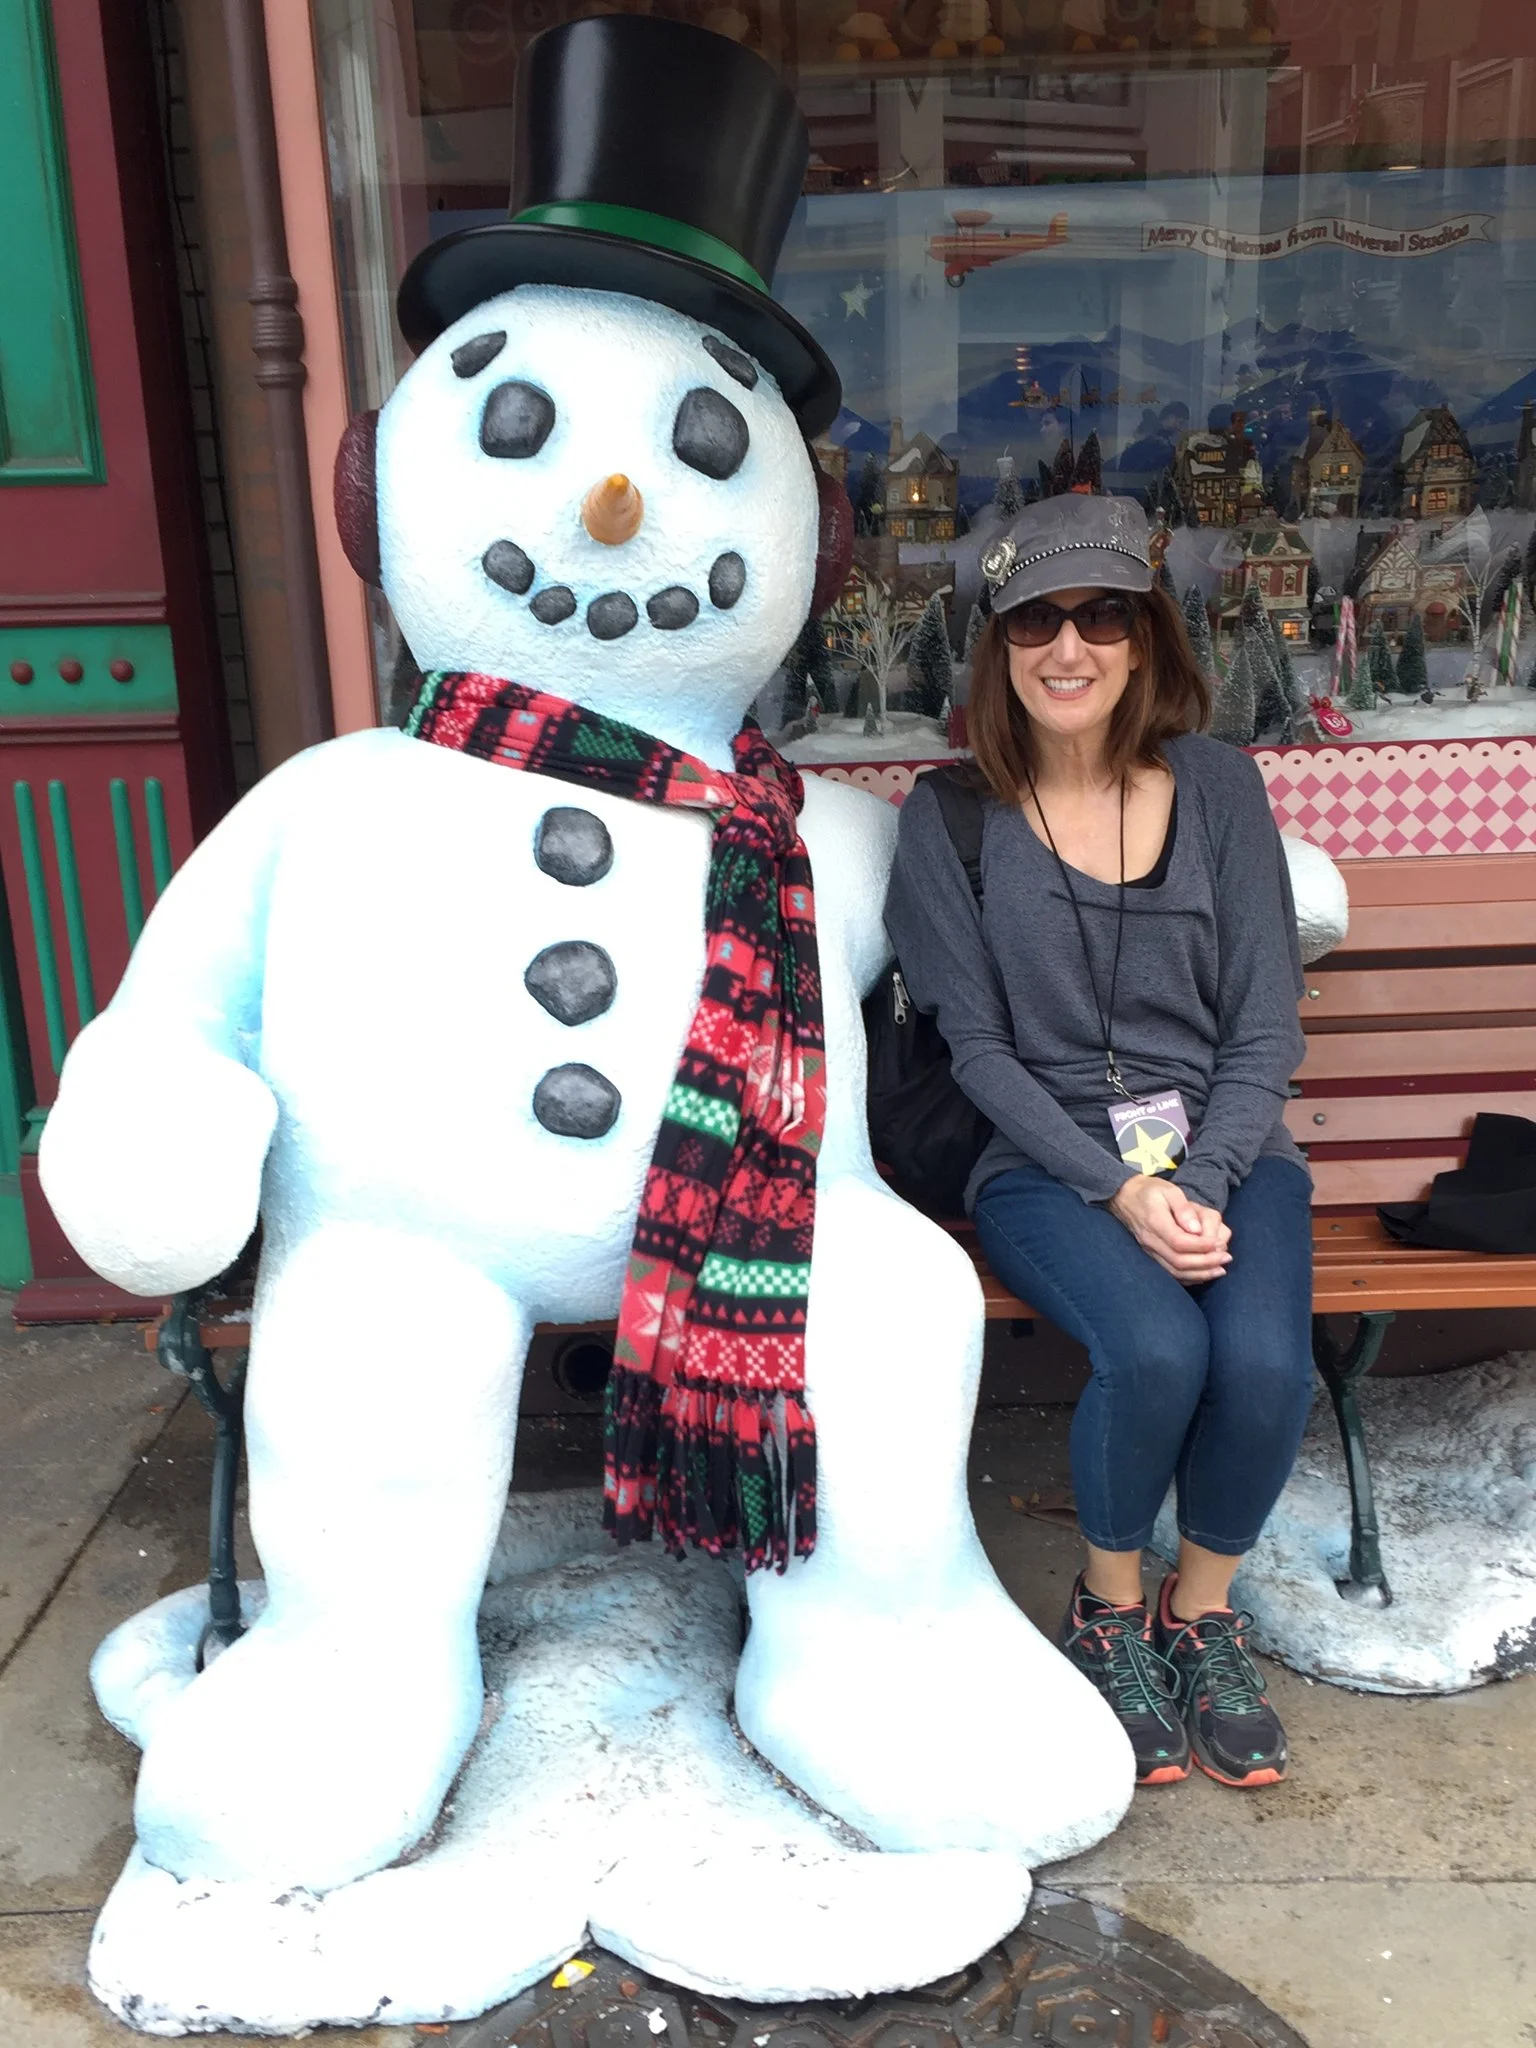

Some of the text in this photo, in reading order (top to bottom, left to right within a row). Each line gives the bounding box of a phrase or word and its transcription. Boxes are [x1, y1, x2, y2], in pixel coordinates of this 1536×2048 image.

[1148, 222, 1469, 255] Merry Christmas from Universal Studios
[1114, 1107, 1146, 1122] FRONT
[1156, 1098, 1179, 1111] LINE
